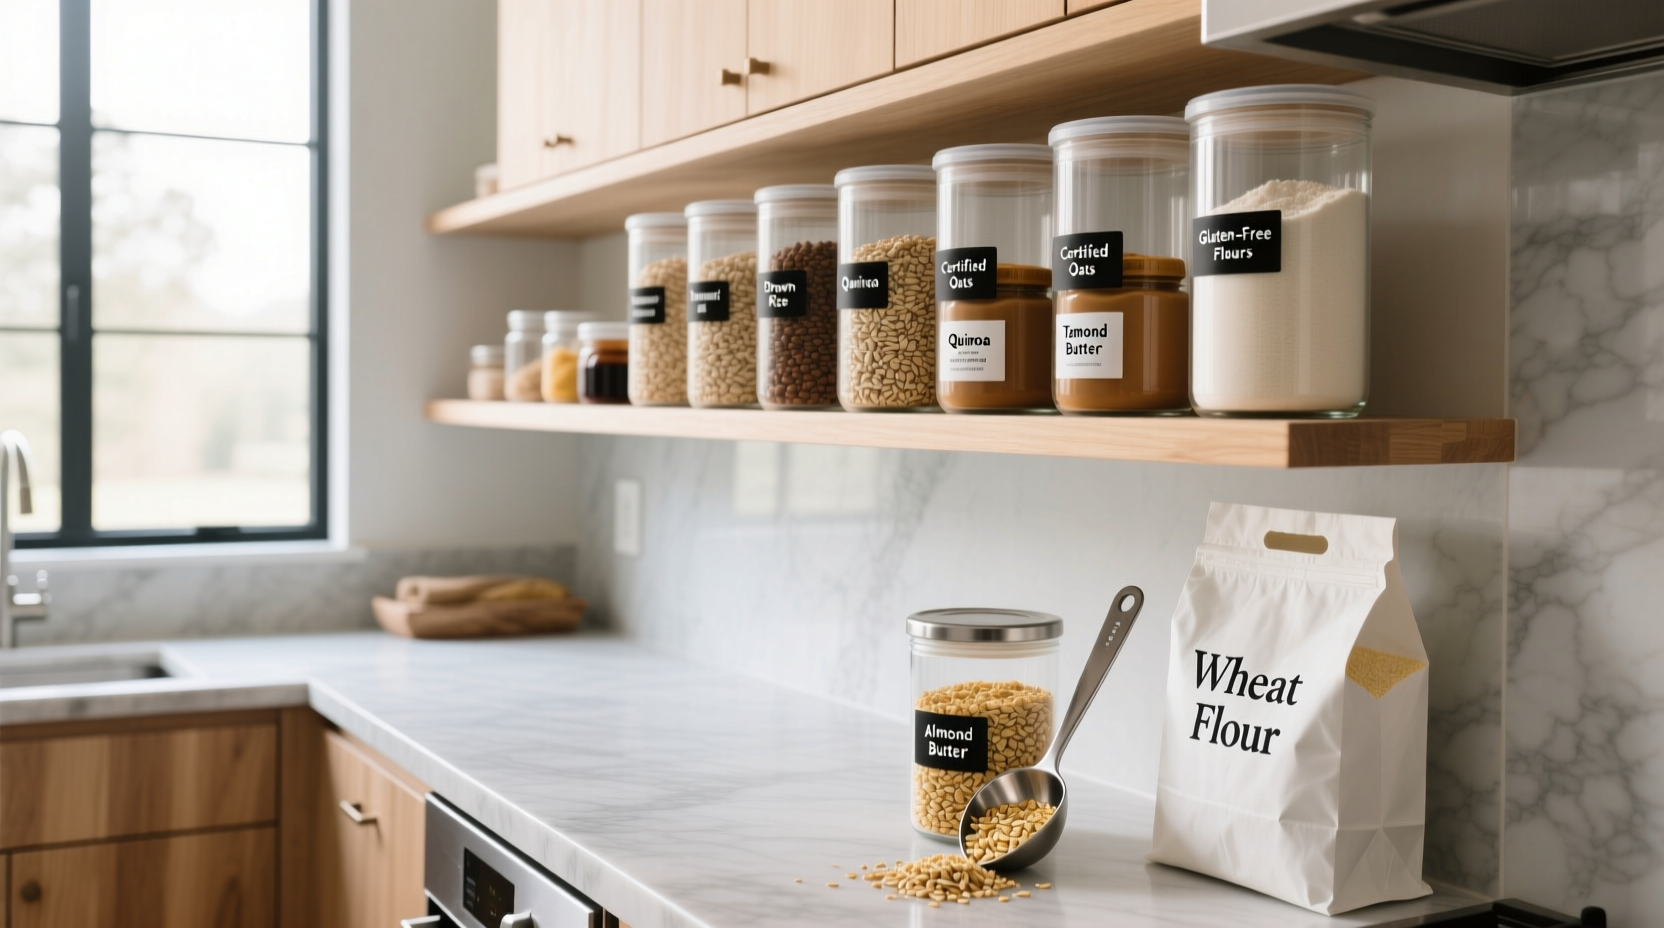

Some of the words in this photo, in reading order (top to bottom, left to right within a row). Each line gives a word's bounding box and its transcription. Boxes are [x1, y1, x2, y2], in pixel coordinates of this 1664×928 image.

[1199, 226, 1272, 245] Gluten-Free
[1213, 246, 1253, 261] Flours
[1068, 262, 1096, 277] Oats
[1066, 342, 1103, 355] Butter
[1195, 649, 1303, 706] Wheat
[924, 723, 973, 741] Almond
[1189, 702, 1281, 755] Flour
